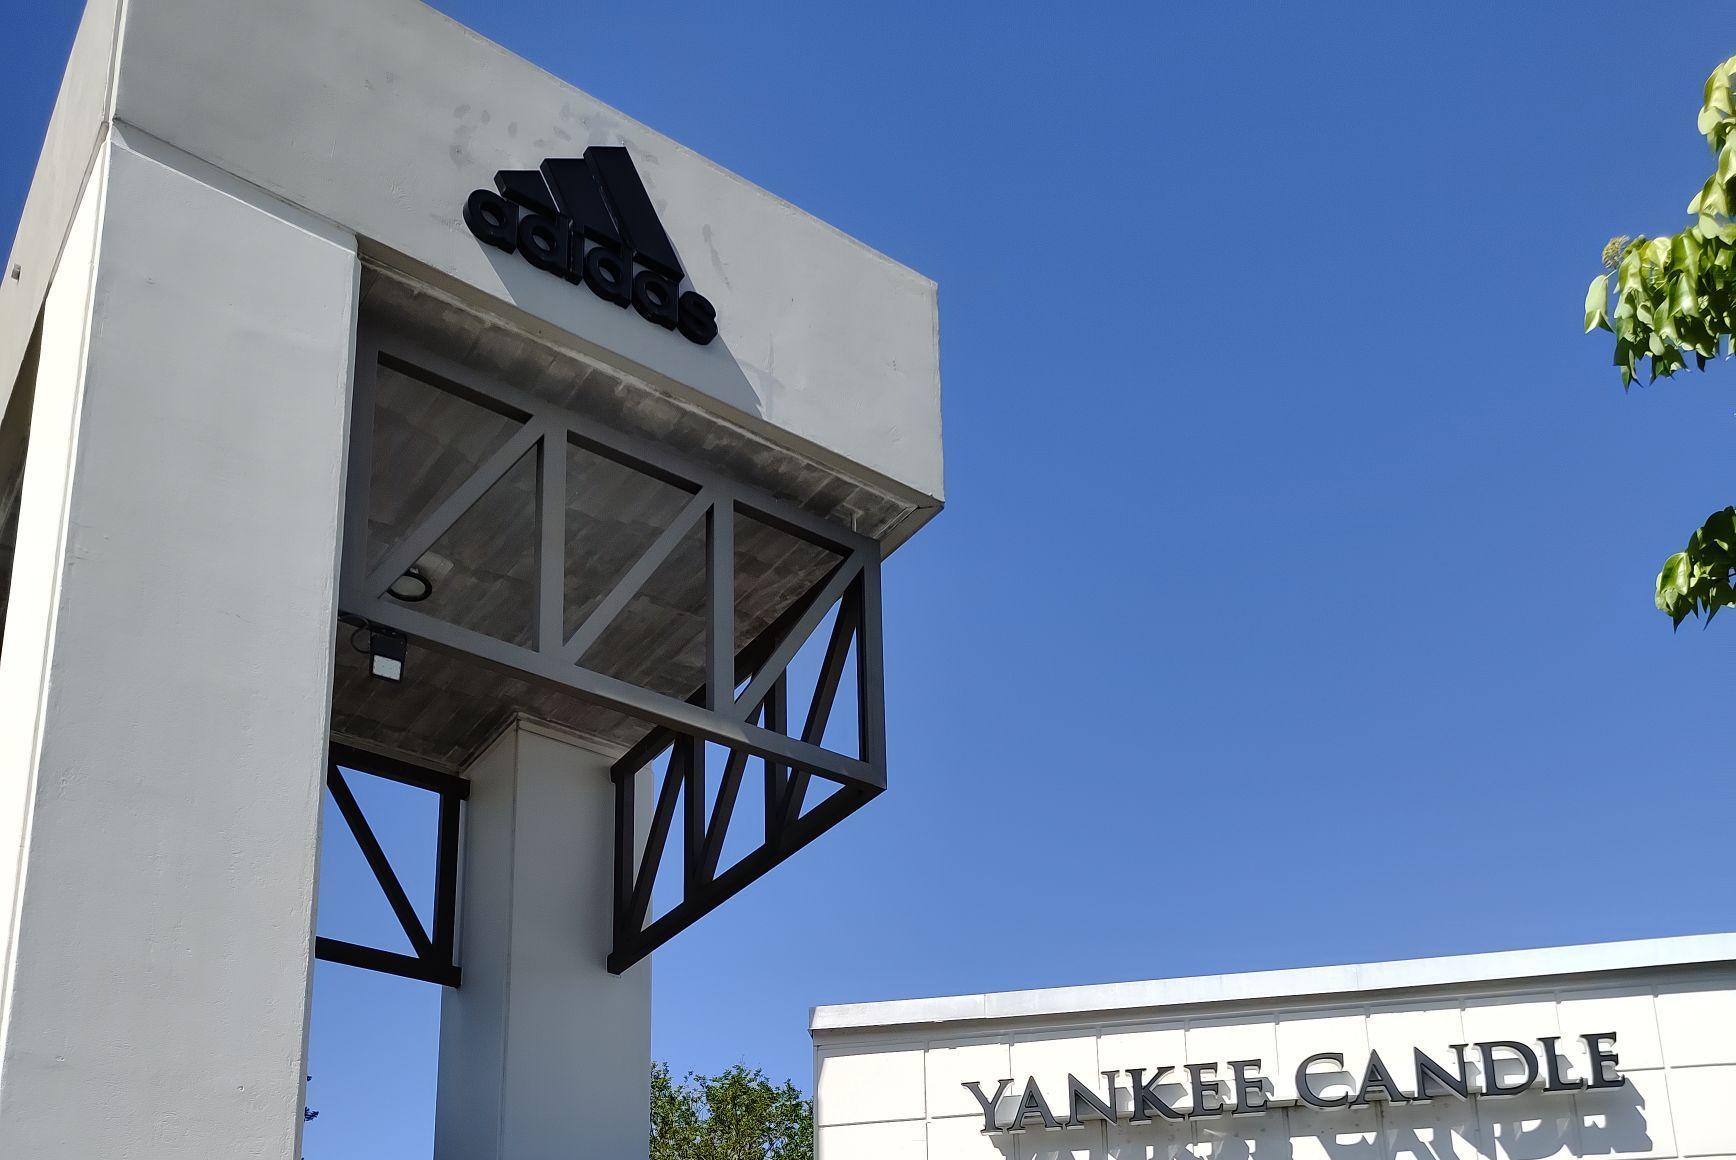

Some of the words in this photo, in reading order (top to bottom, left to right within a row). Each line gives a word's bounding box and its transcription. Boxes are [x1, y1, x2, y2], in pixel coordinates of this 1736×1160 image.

[463, 188, 719, 346] adidas
[961, 1058, 1269, 1133] YANKEE
[1295, 1031, 1626, 1109] CANDLE
